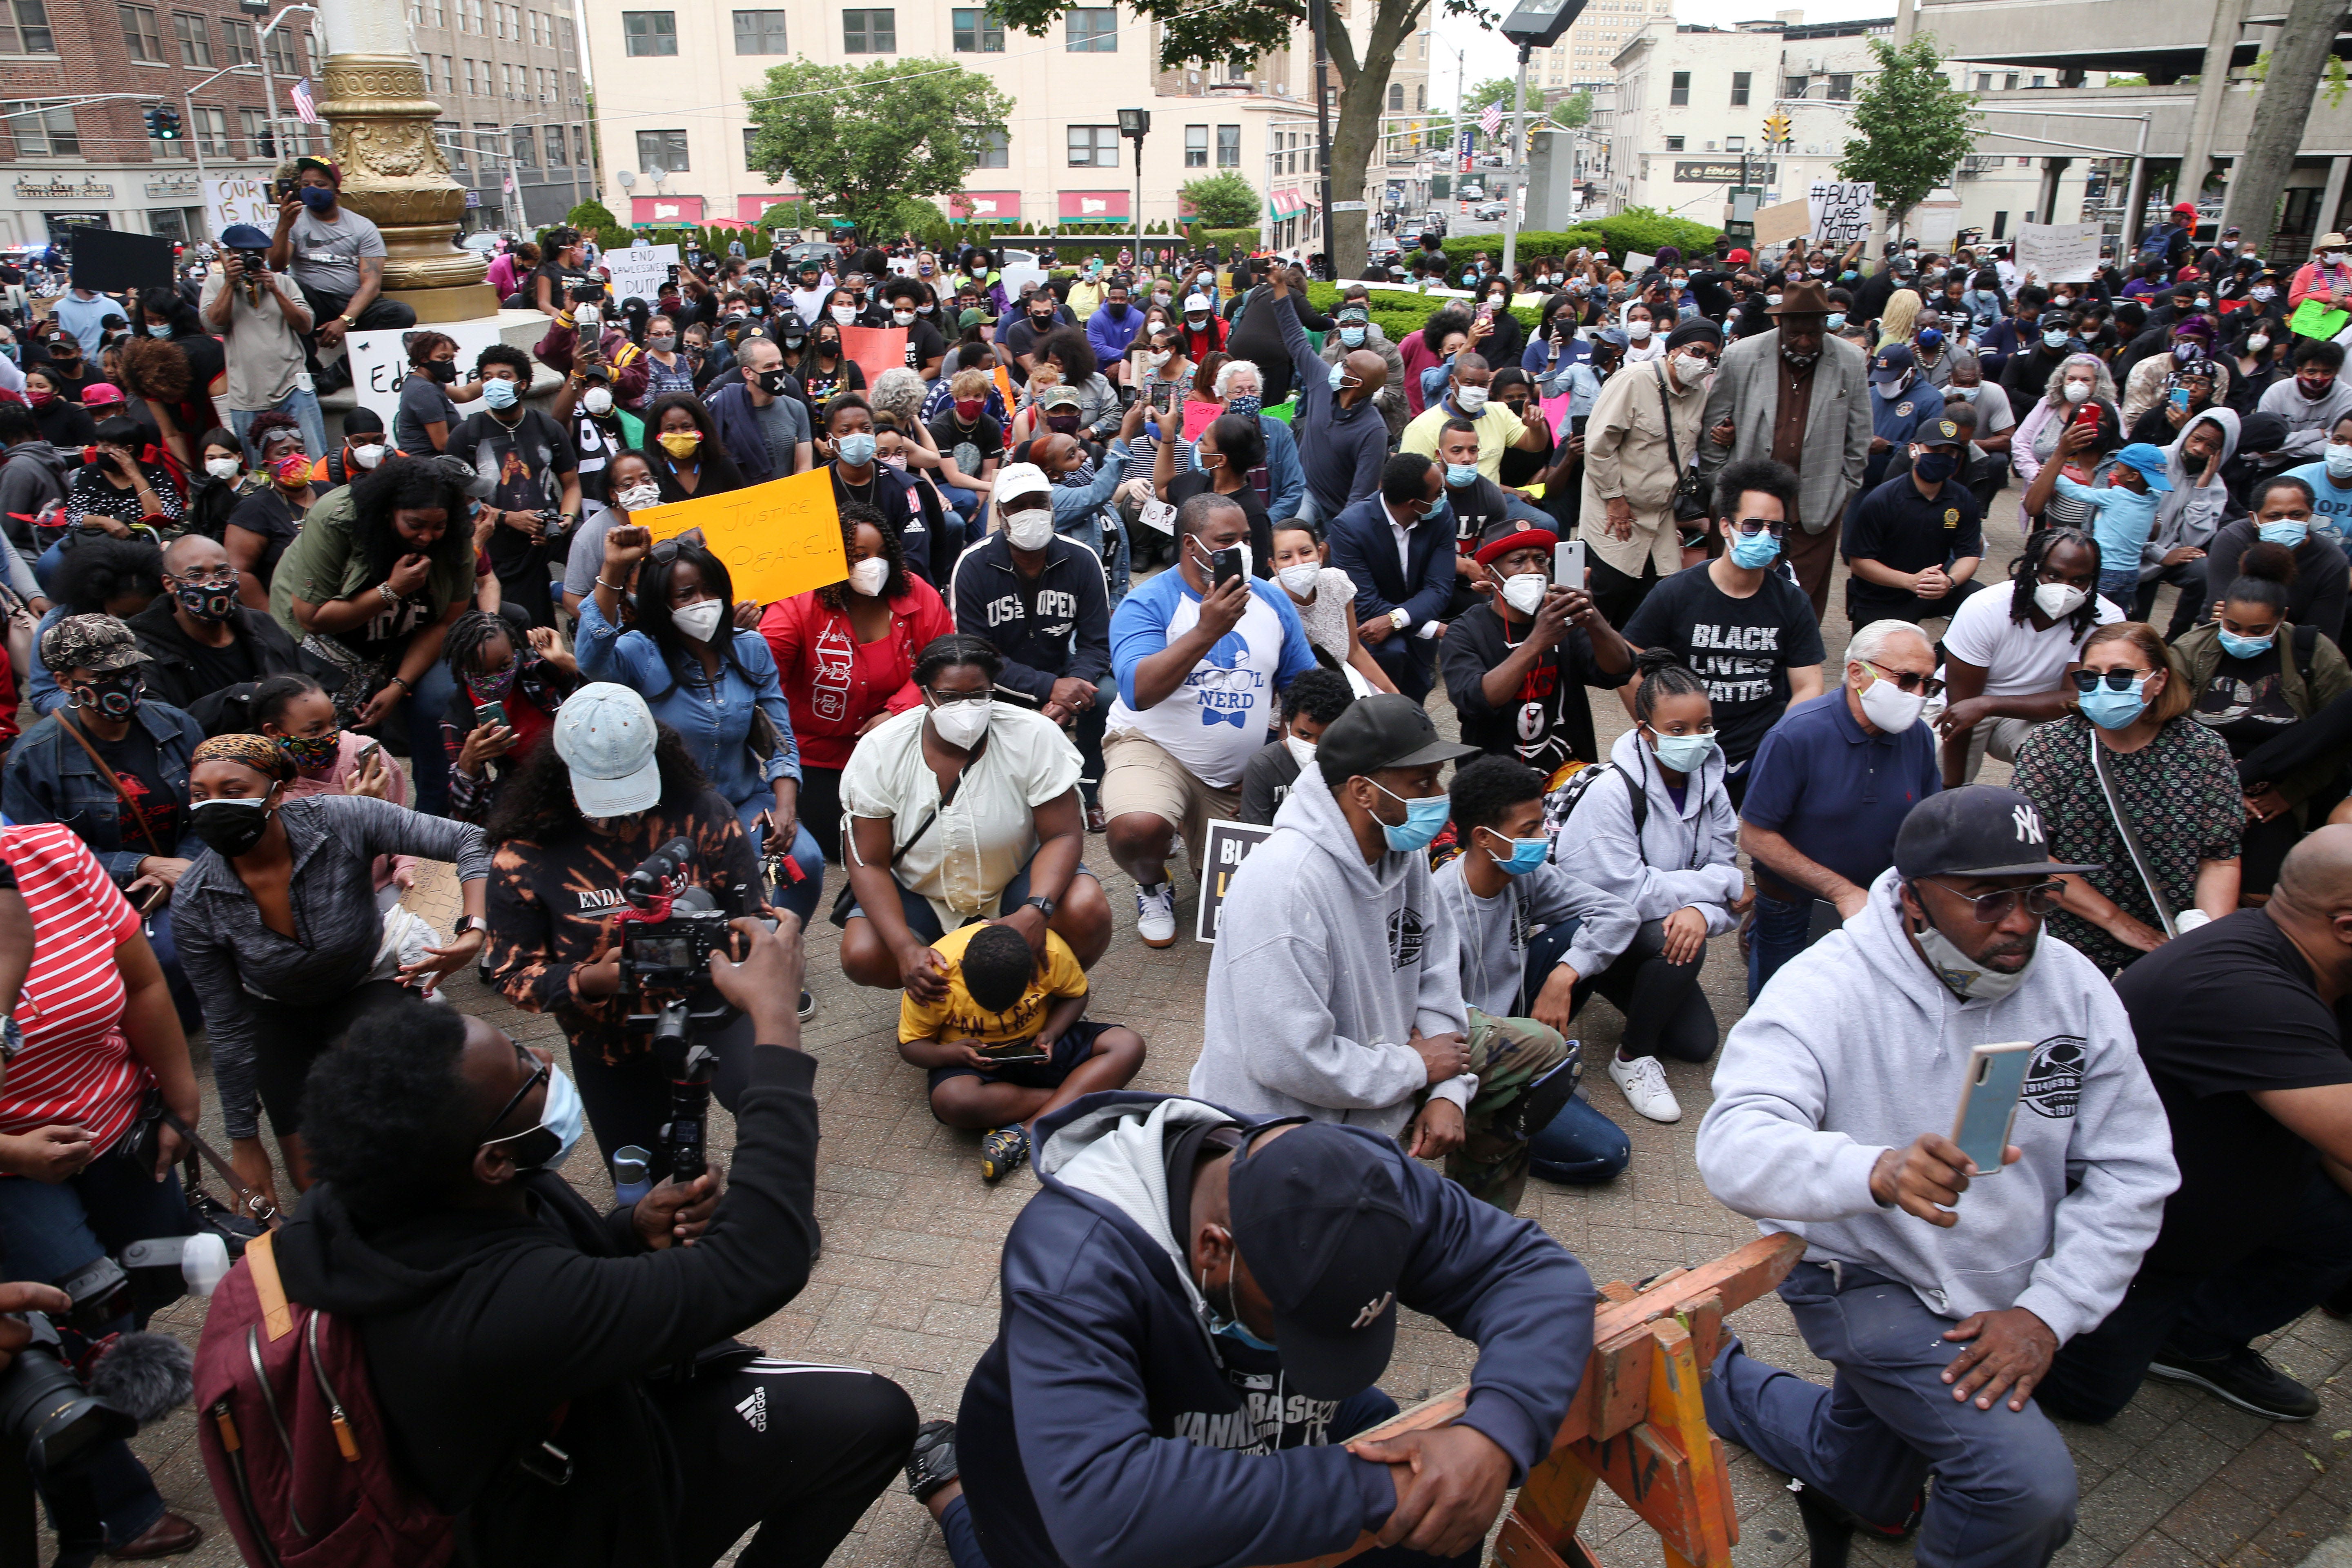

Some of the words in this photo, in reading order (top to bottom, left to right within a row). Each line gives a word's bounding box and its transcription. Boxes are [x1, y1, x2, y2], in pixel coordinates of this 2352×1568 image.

[218, 181, 263, 200] OUR
[218, 202, 239, 223] IS
[1817, 218, 1871, 241] Matter
[631, 250, 655, 262] END
[722, 499, 811, 531] JUSTICE
[1143, 506, 1158, 519] NO
[1036, 589, 1077, 618] OPEN
[1691, 624, 1780, 650] BLACK
[1689, 655, 1775, 675] LIVES
[1197, 689, 1254, 709] NERD
[755, 1385, 767, 1433] adidas
